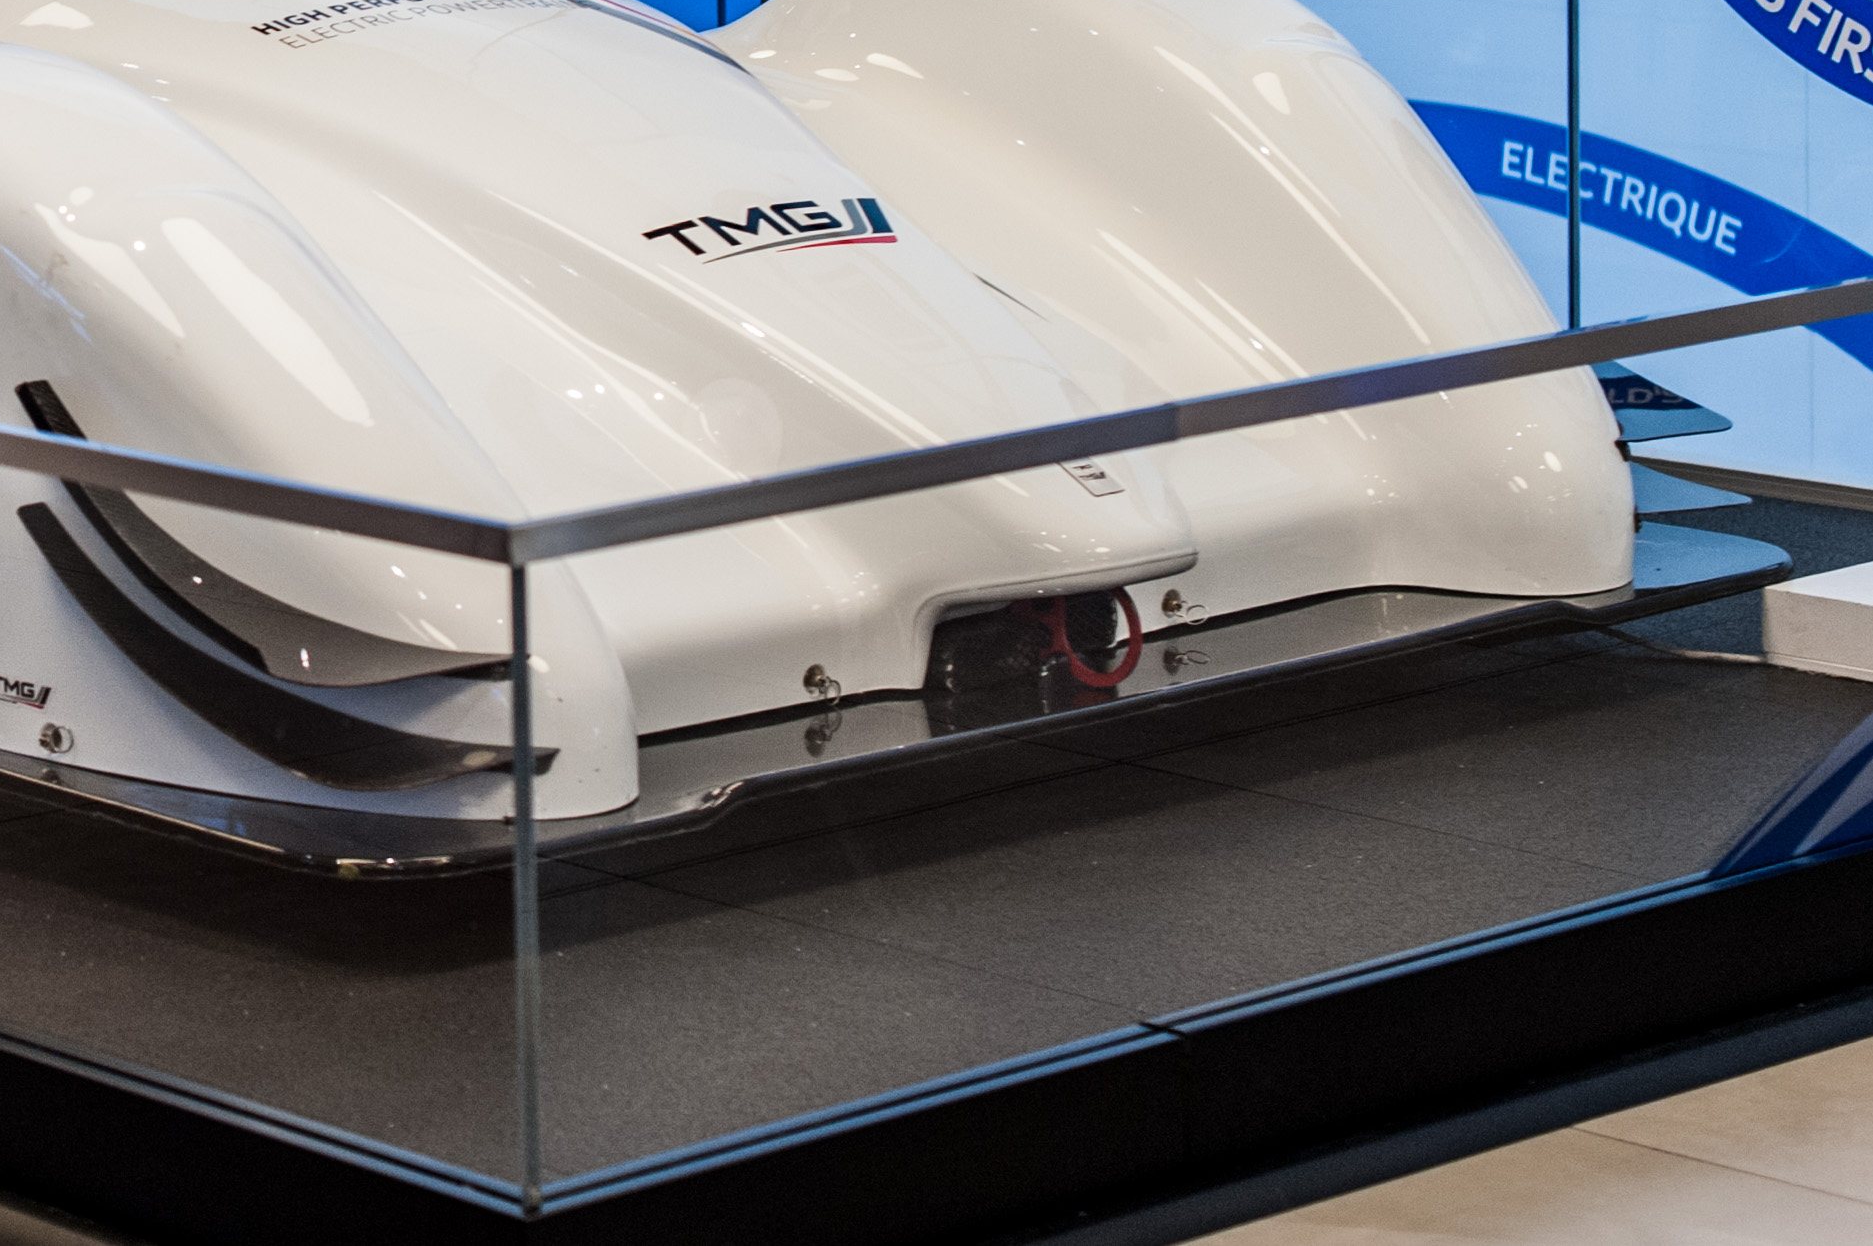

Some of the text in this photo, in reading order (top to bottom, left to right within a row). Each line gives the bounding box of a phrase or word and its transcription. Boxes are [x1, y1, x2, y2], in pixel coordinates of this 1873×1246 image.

[250, 9, 332, 36] HIGH
[278, 9, 414, 49] ELECTRIC
[1501, 140, 1743, 257] ELECTRIQUE
